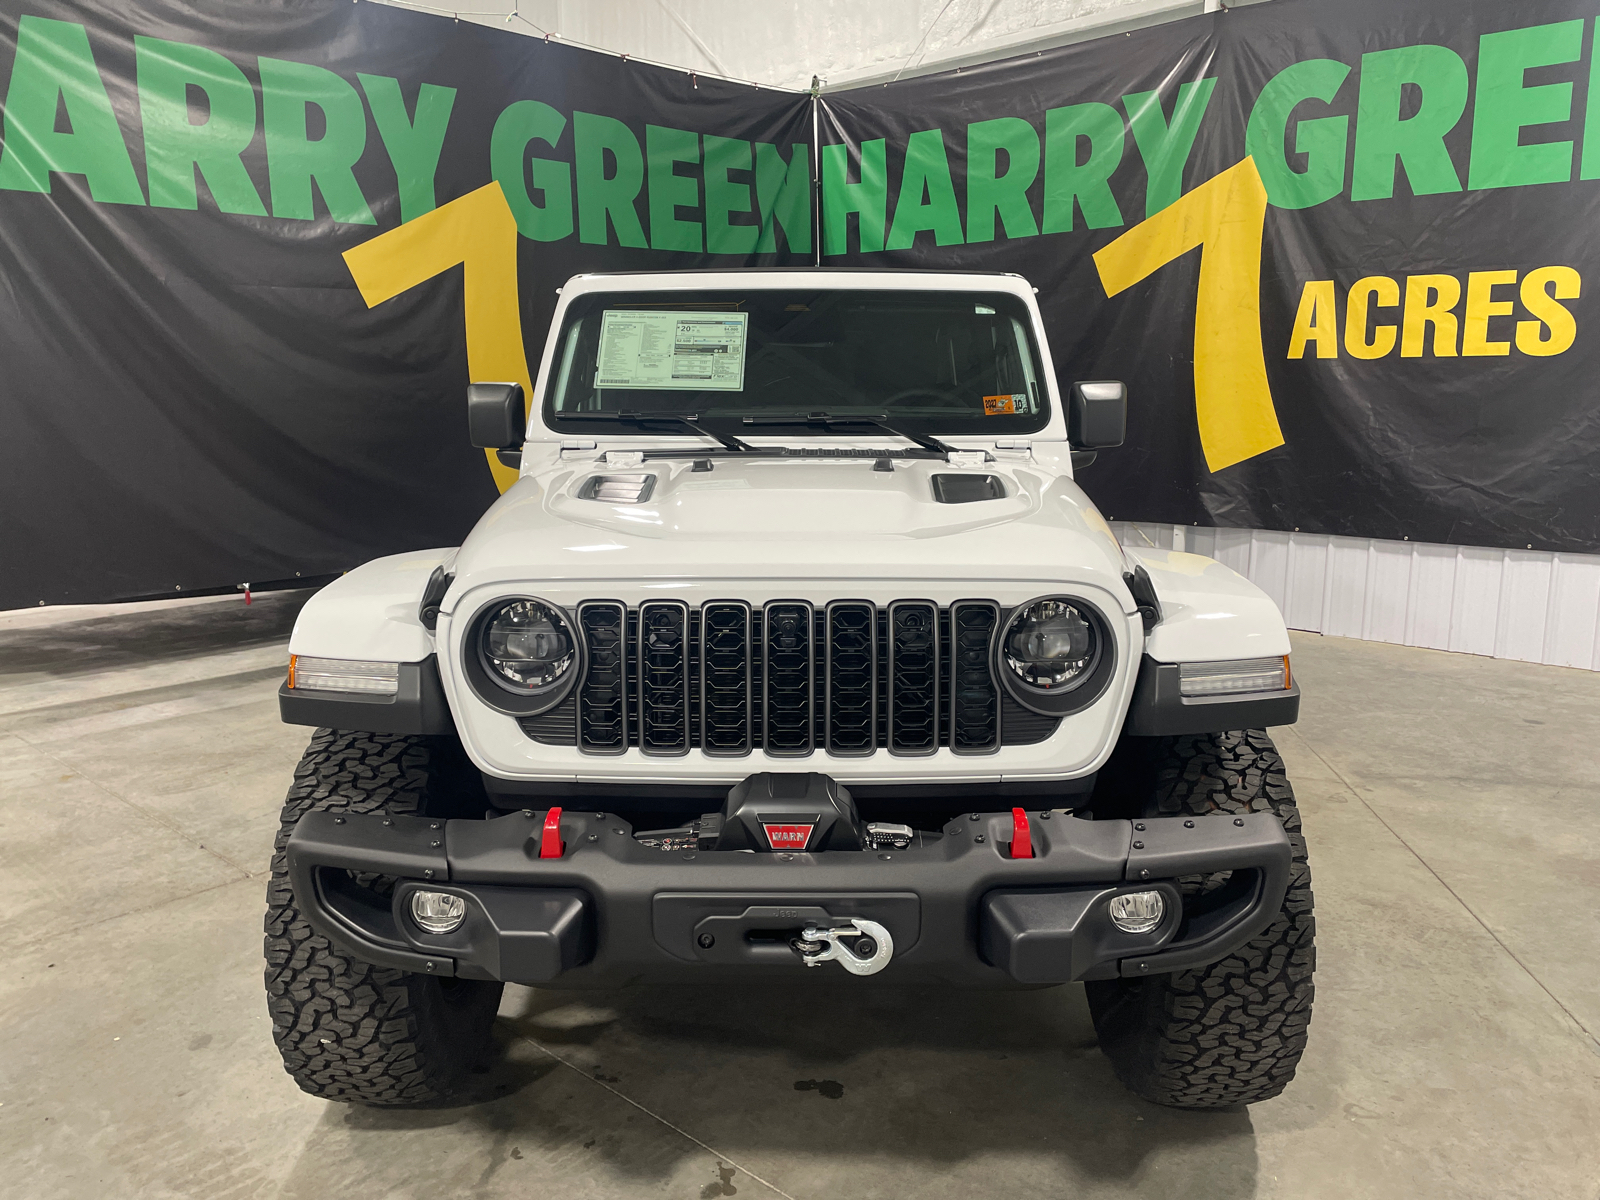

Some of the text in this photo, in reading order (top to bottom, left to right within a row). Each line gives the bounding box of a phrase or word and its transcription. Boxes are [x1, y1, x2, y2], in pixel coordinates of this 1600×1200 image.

[490, 100, 812, 254] GREEN
[822, 15, 1600, 256] HARRY GRE
[1092, 154, 1582, 473] 7 ACRES
[771, 831, 805, 842] WARN
